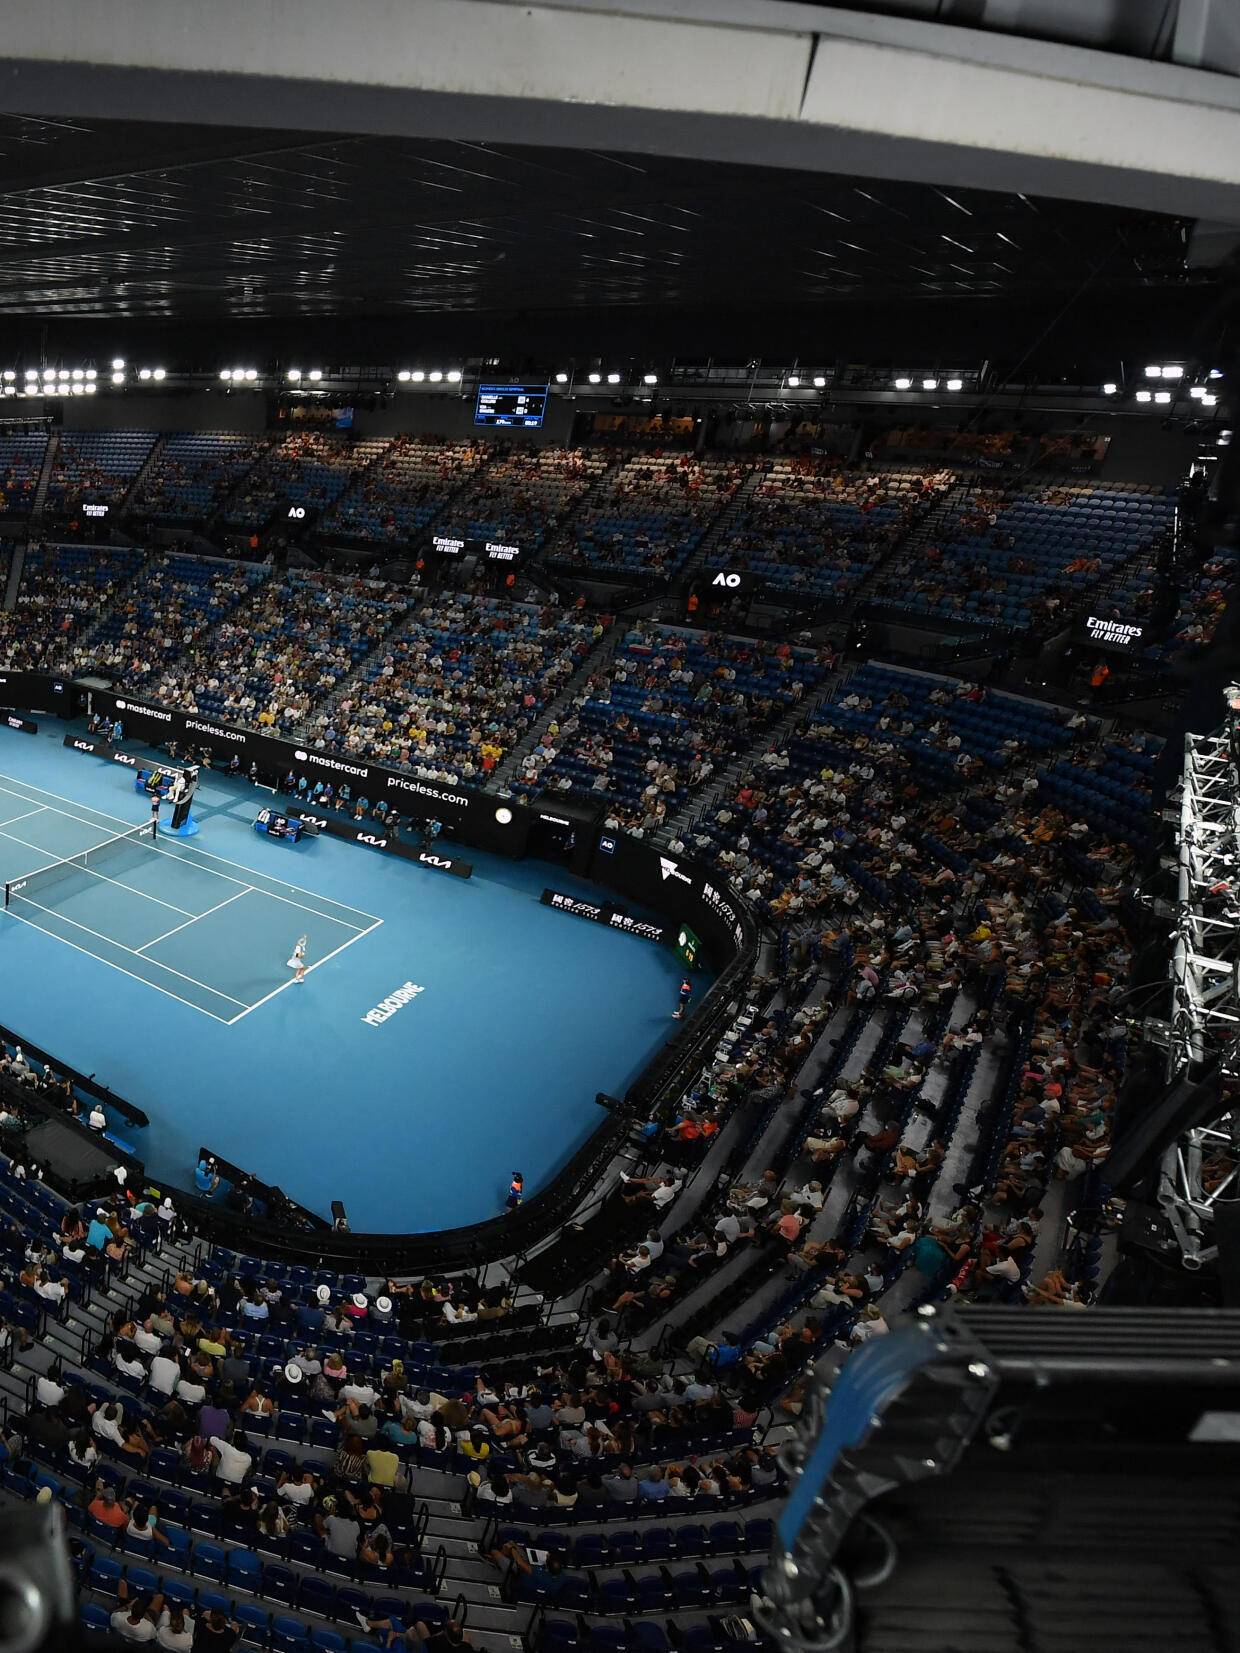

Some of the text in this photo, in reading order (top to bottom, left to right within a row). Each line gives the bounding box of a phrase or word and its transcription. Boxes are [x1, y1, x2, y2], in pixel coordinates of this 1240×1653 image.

[288, 507, 305, 518] AO
[433, 536, 464, 548] Emirates
[486, 543, 519, 554] Emirates
[712, 572, 741, 588] AO
[1087, 616, 1142, 637] Emirates
[1090, 629, 1131, 645] FLY BETTER
[127, 703, 171, 721] mastercard
[186, 720, 246, 744] priceless.com
[309, 754, 368, 778] mastercard
[387, 777, 468, 807] priceless.com
[602, 840, 613, 849] AO
[360, 981, 425, 1027] MELBOURNE
